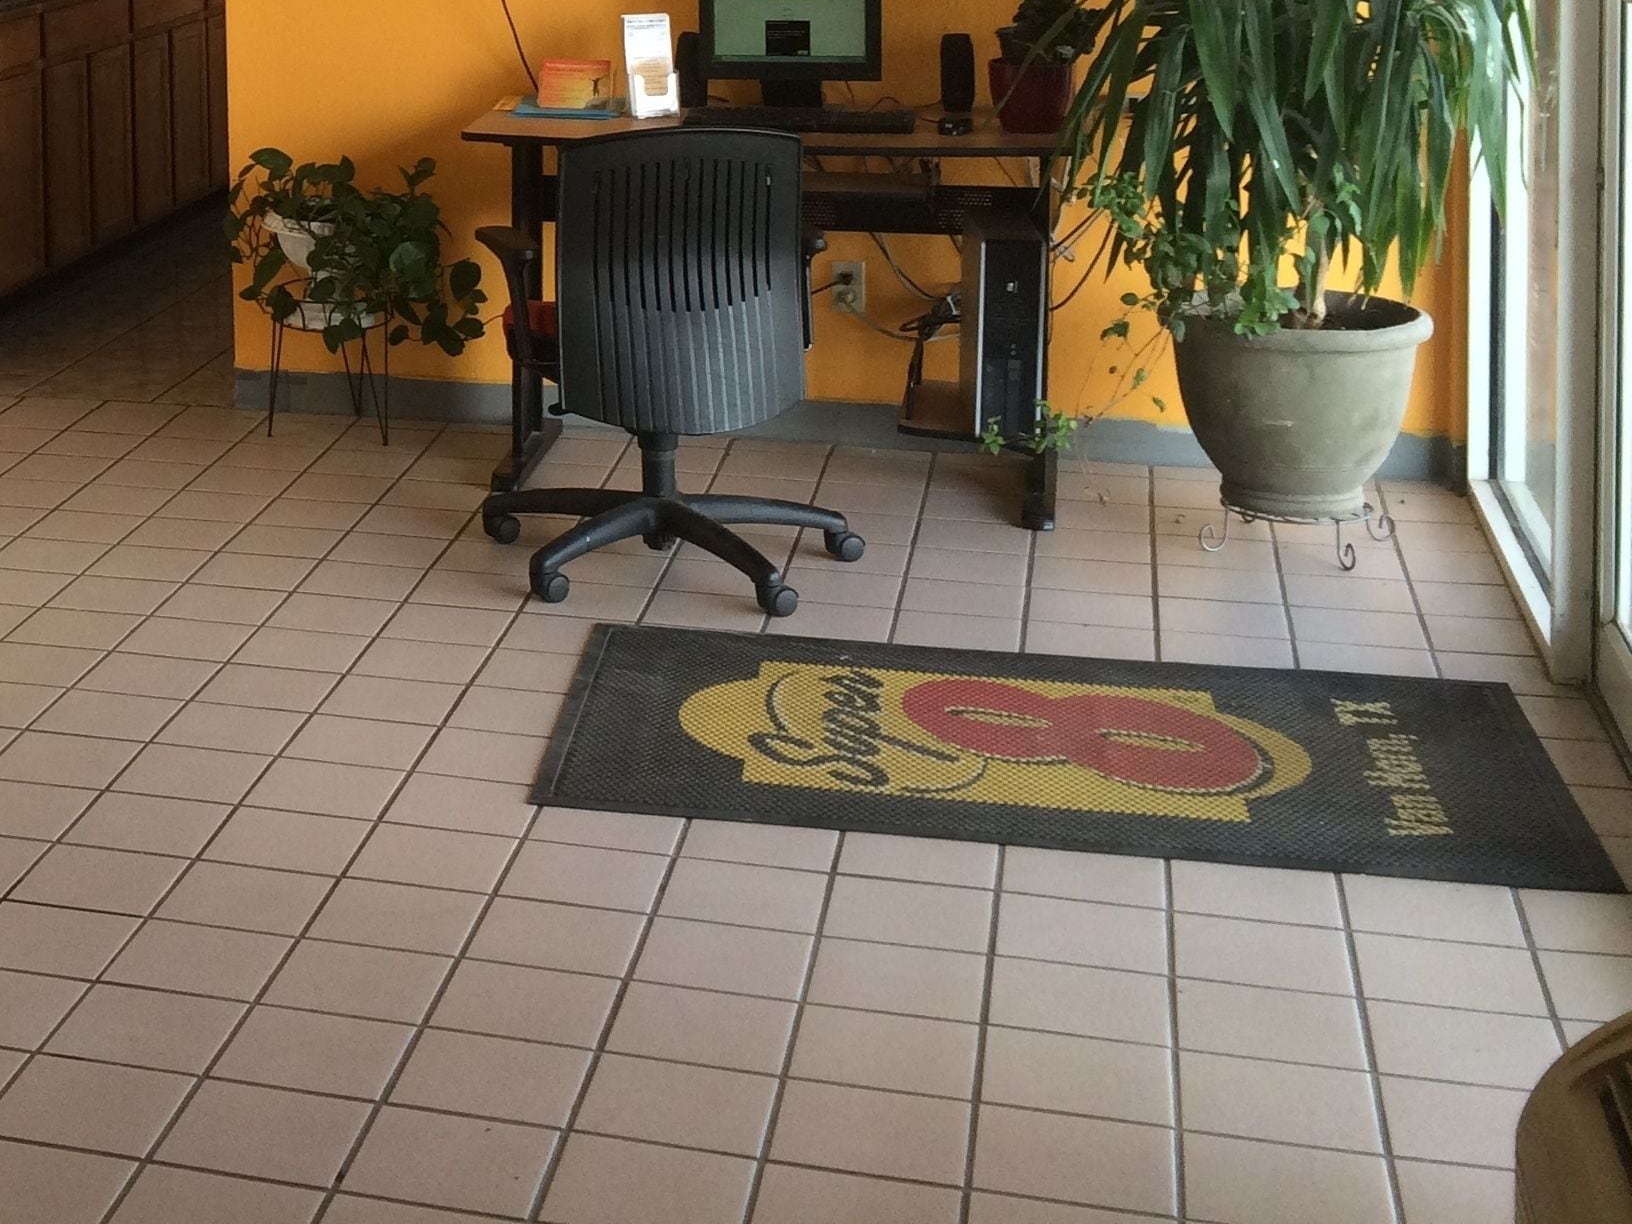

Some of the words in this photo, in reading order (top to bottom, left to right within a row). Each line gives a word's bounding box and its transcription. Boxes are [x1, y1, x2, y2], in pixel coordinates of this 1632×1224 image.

[748, 671, 960, 788] Super
[901, 678, 1274, 796] 8
[1330, 697, 1398, 726] TX
[1384, 794, 1454, 836] Van
